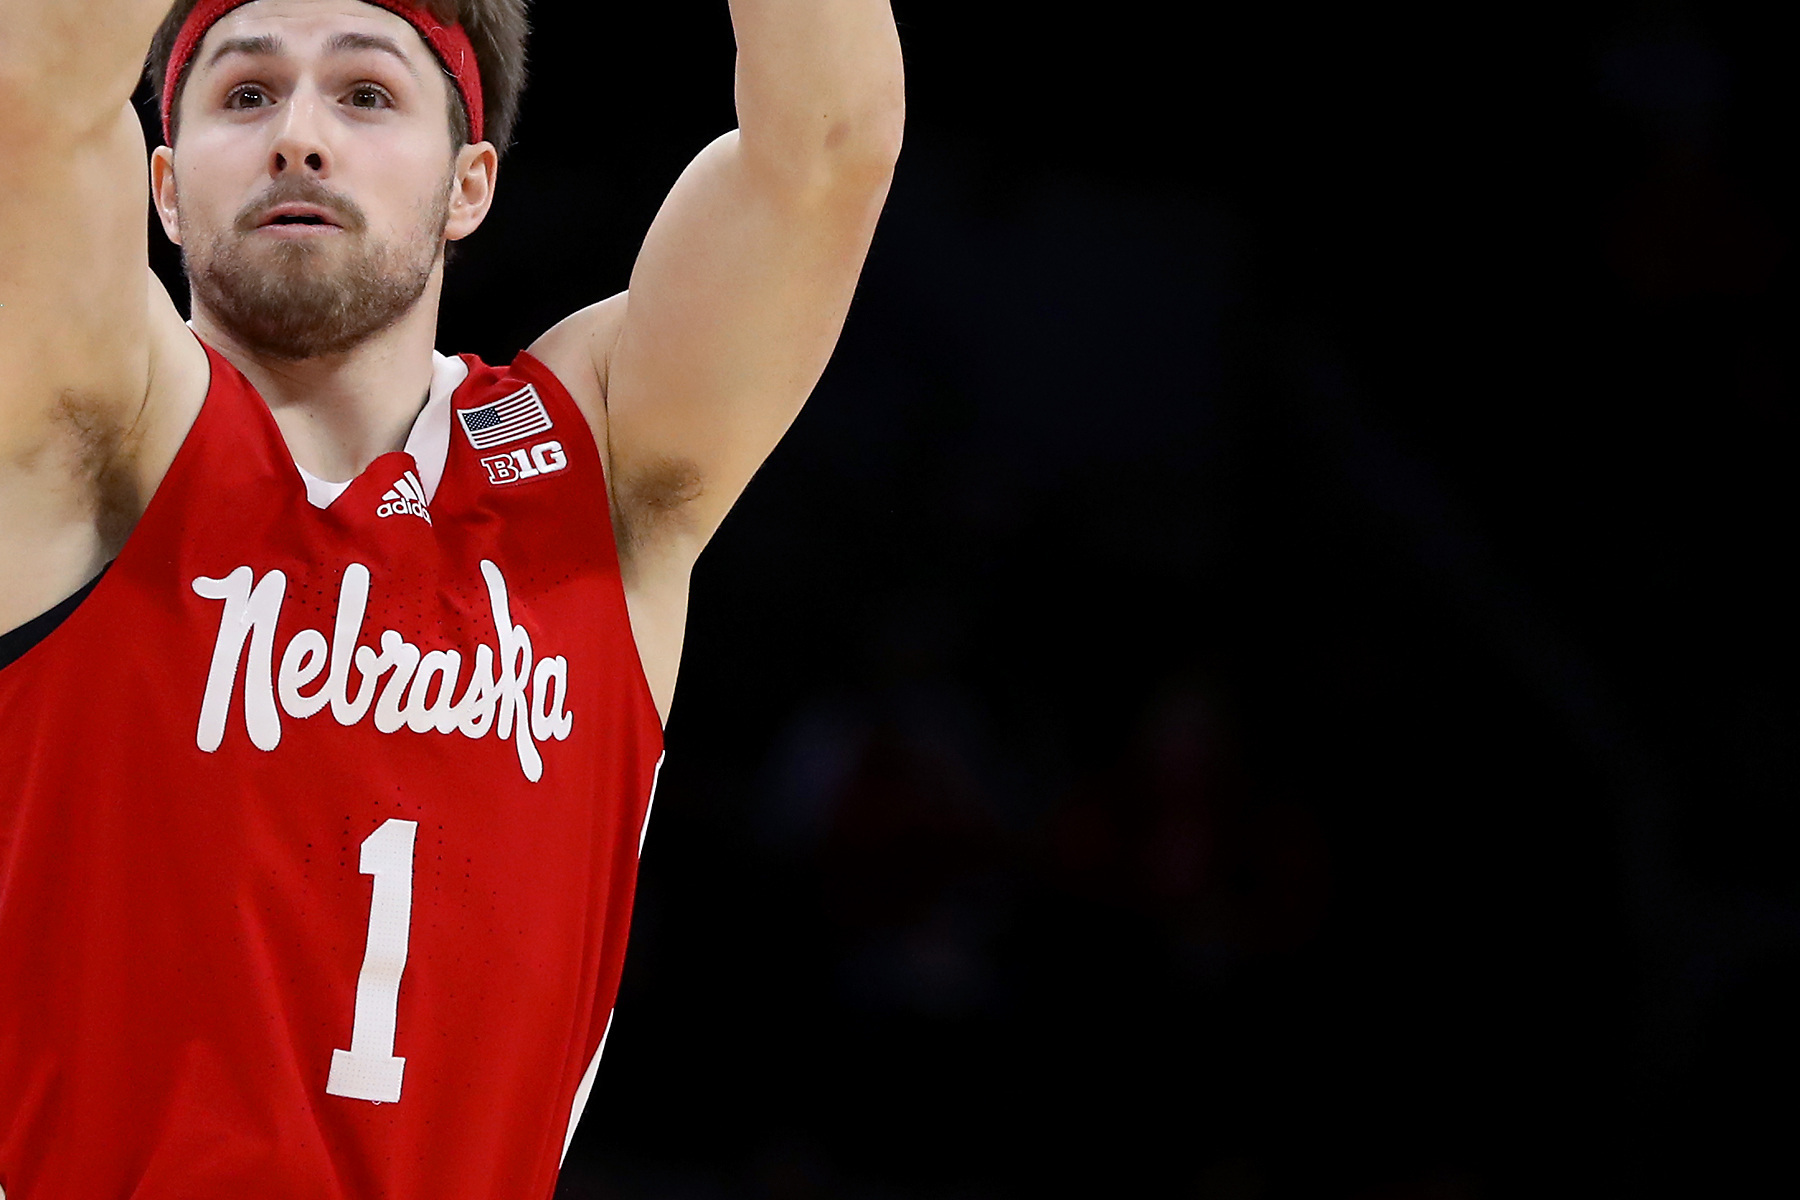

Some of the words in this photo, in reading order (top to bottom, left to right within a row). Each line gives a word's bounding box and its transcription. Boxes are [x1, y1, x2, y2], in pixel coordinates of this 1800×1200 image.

[376, 497, 432, 527] adida
[191, 559, 573, 783] Nebraska
[326, 817, 419, 1104] 1
